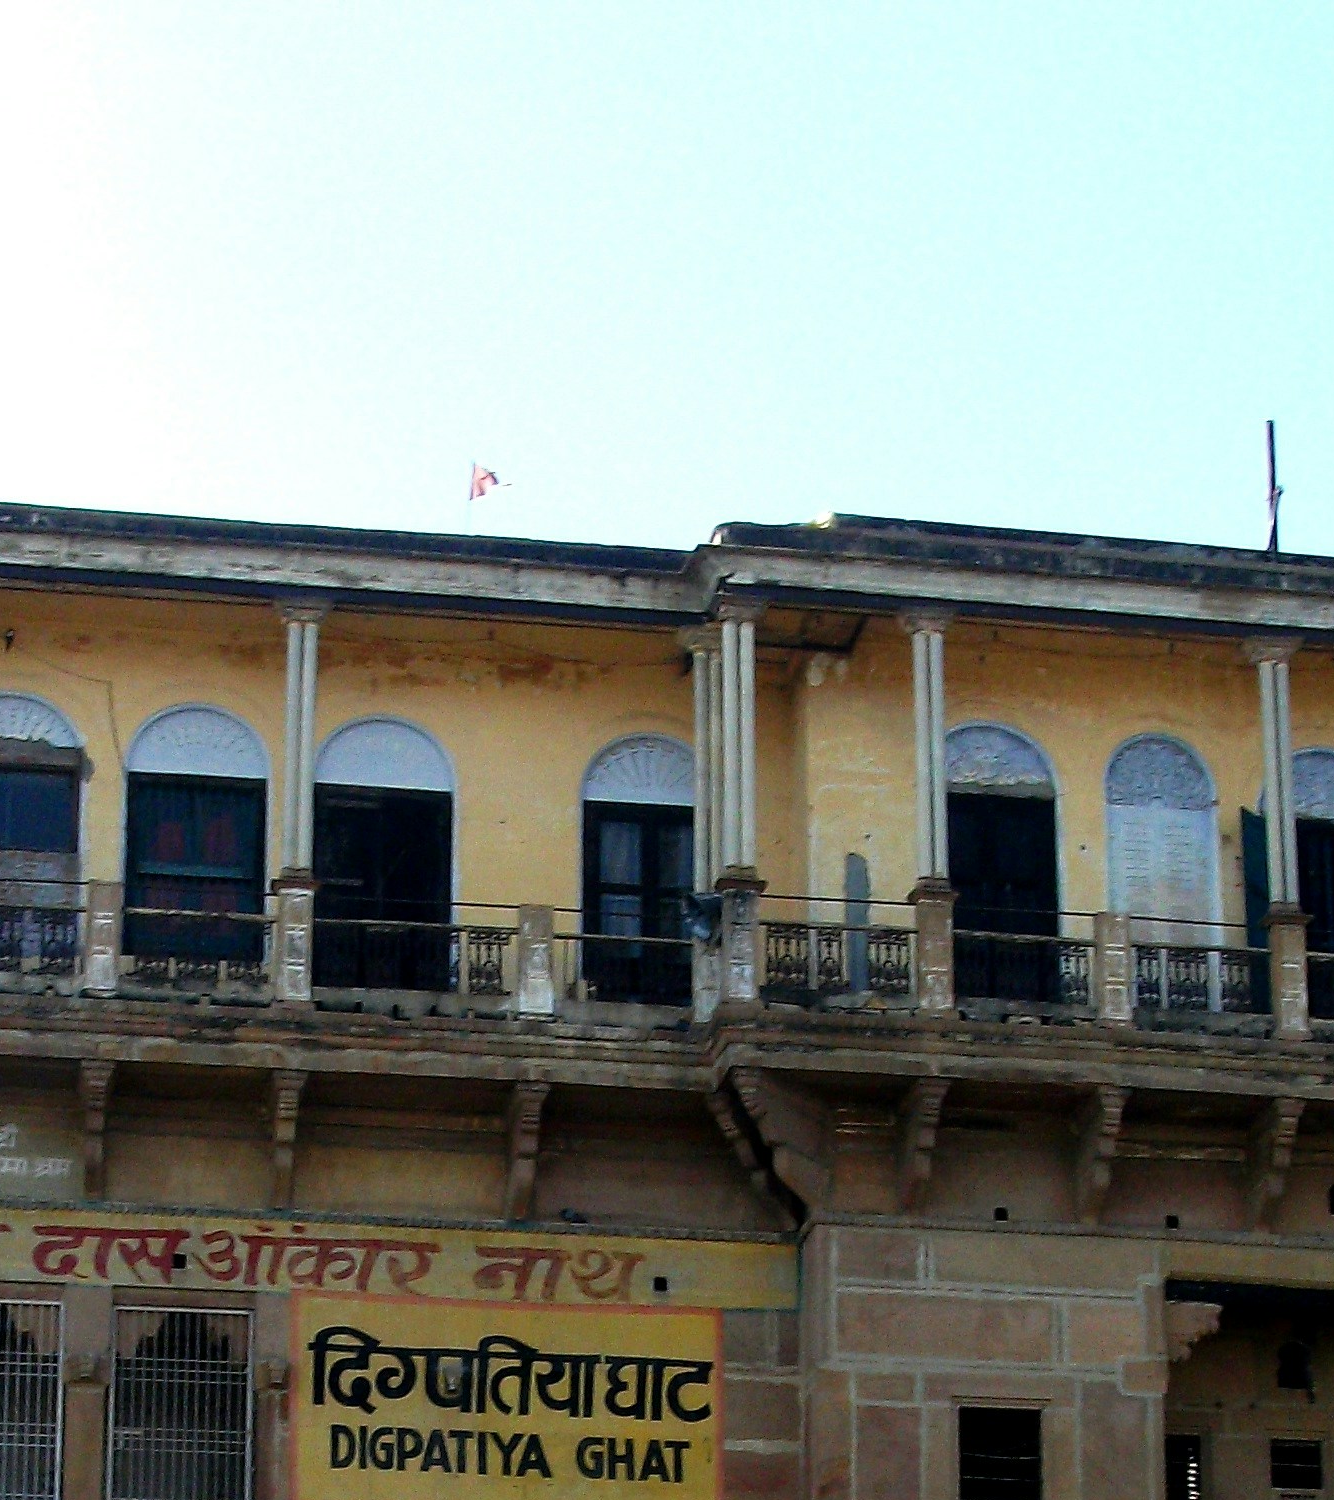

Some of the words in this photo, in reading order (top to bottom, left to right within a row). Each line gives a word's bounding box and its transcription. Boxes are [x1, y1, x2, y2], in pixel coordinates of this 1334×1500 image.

[32, 1225, 188, 1284] दास
[474, 1246, 647, 1301] नाथ
[328, 1423, 553, 1480] DIGPATIYA
[575, 1435, 691, 1485] GHAT
